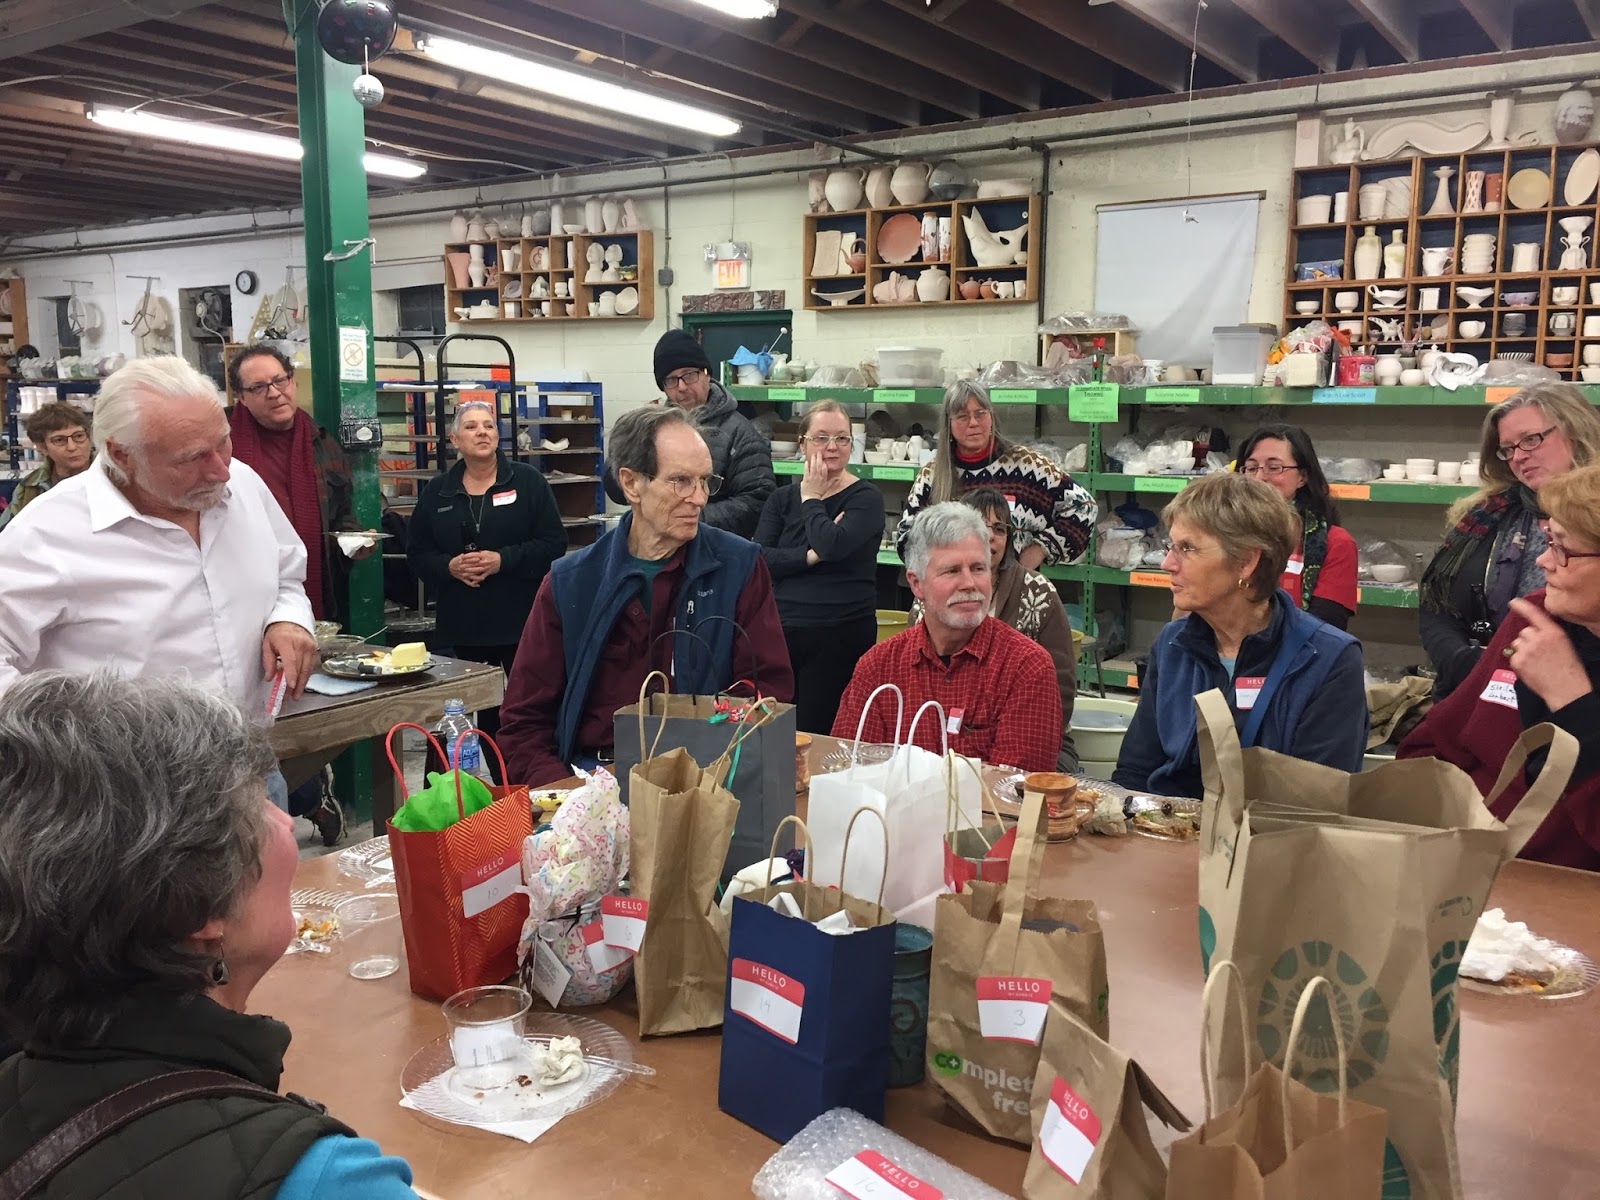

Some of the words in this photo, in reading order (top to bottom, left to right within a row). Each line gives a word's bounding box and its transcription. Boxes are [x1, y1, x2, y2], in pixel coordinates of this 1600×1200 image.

[718, 261, 743, 286] EXIT
[476, 856, 504, 877] HELLO
[615, 900, 642, 911] HELLO
[752, 966, 786, 988] HELLO
[998, 981, 1040, 993] HELLO
[1013, 1009, 1026, 1026] 3
[879, 1161, 919, 1189] HELLO
